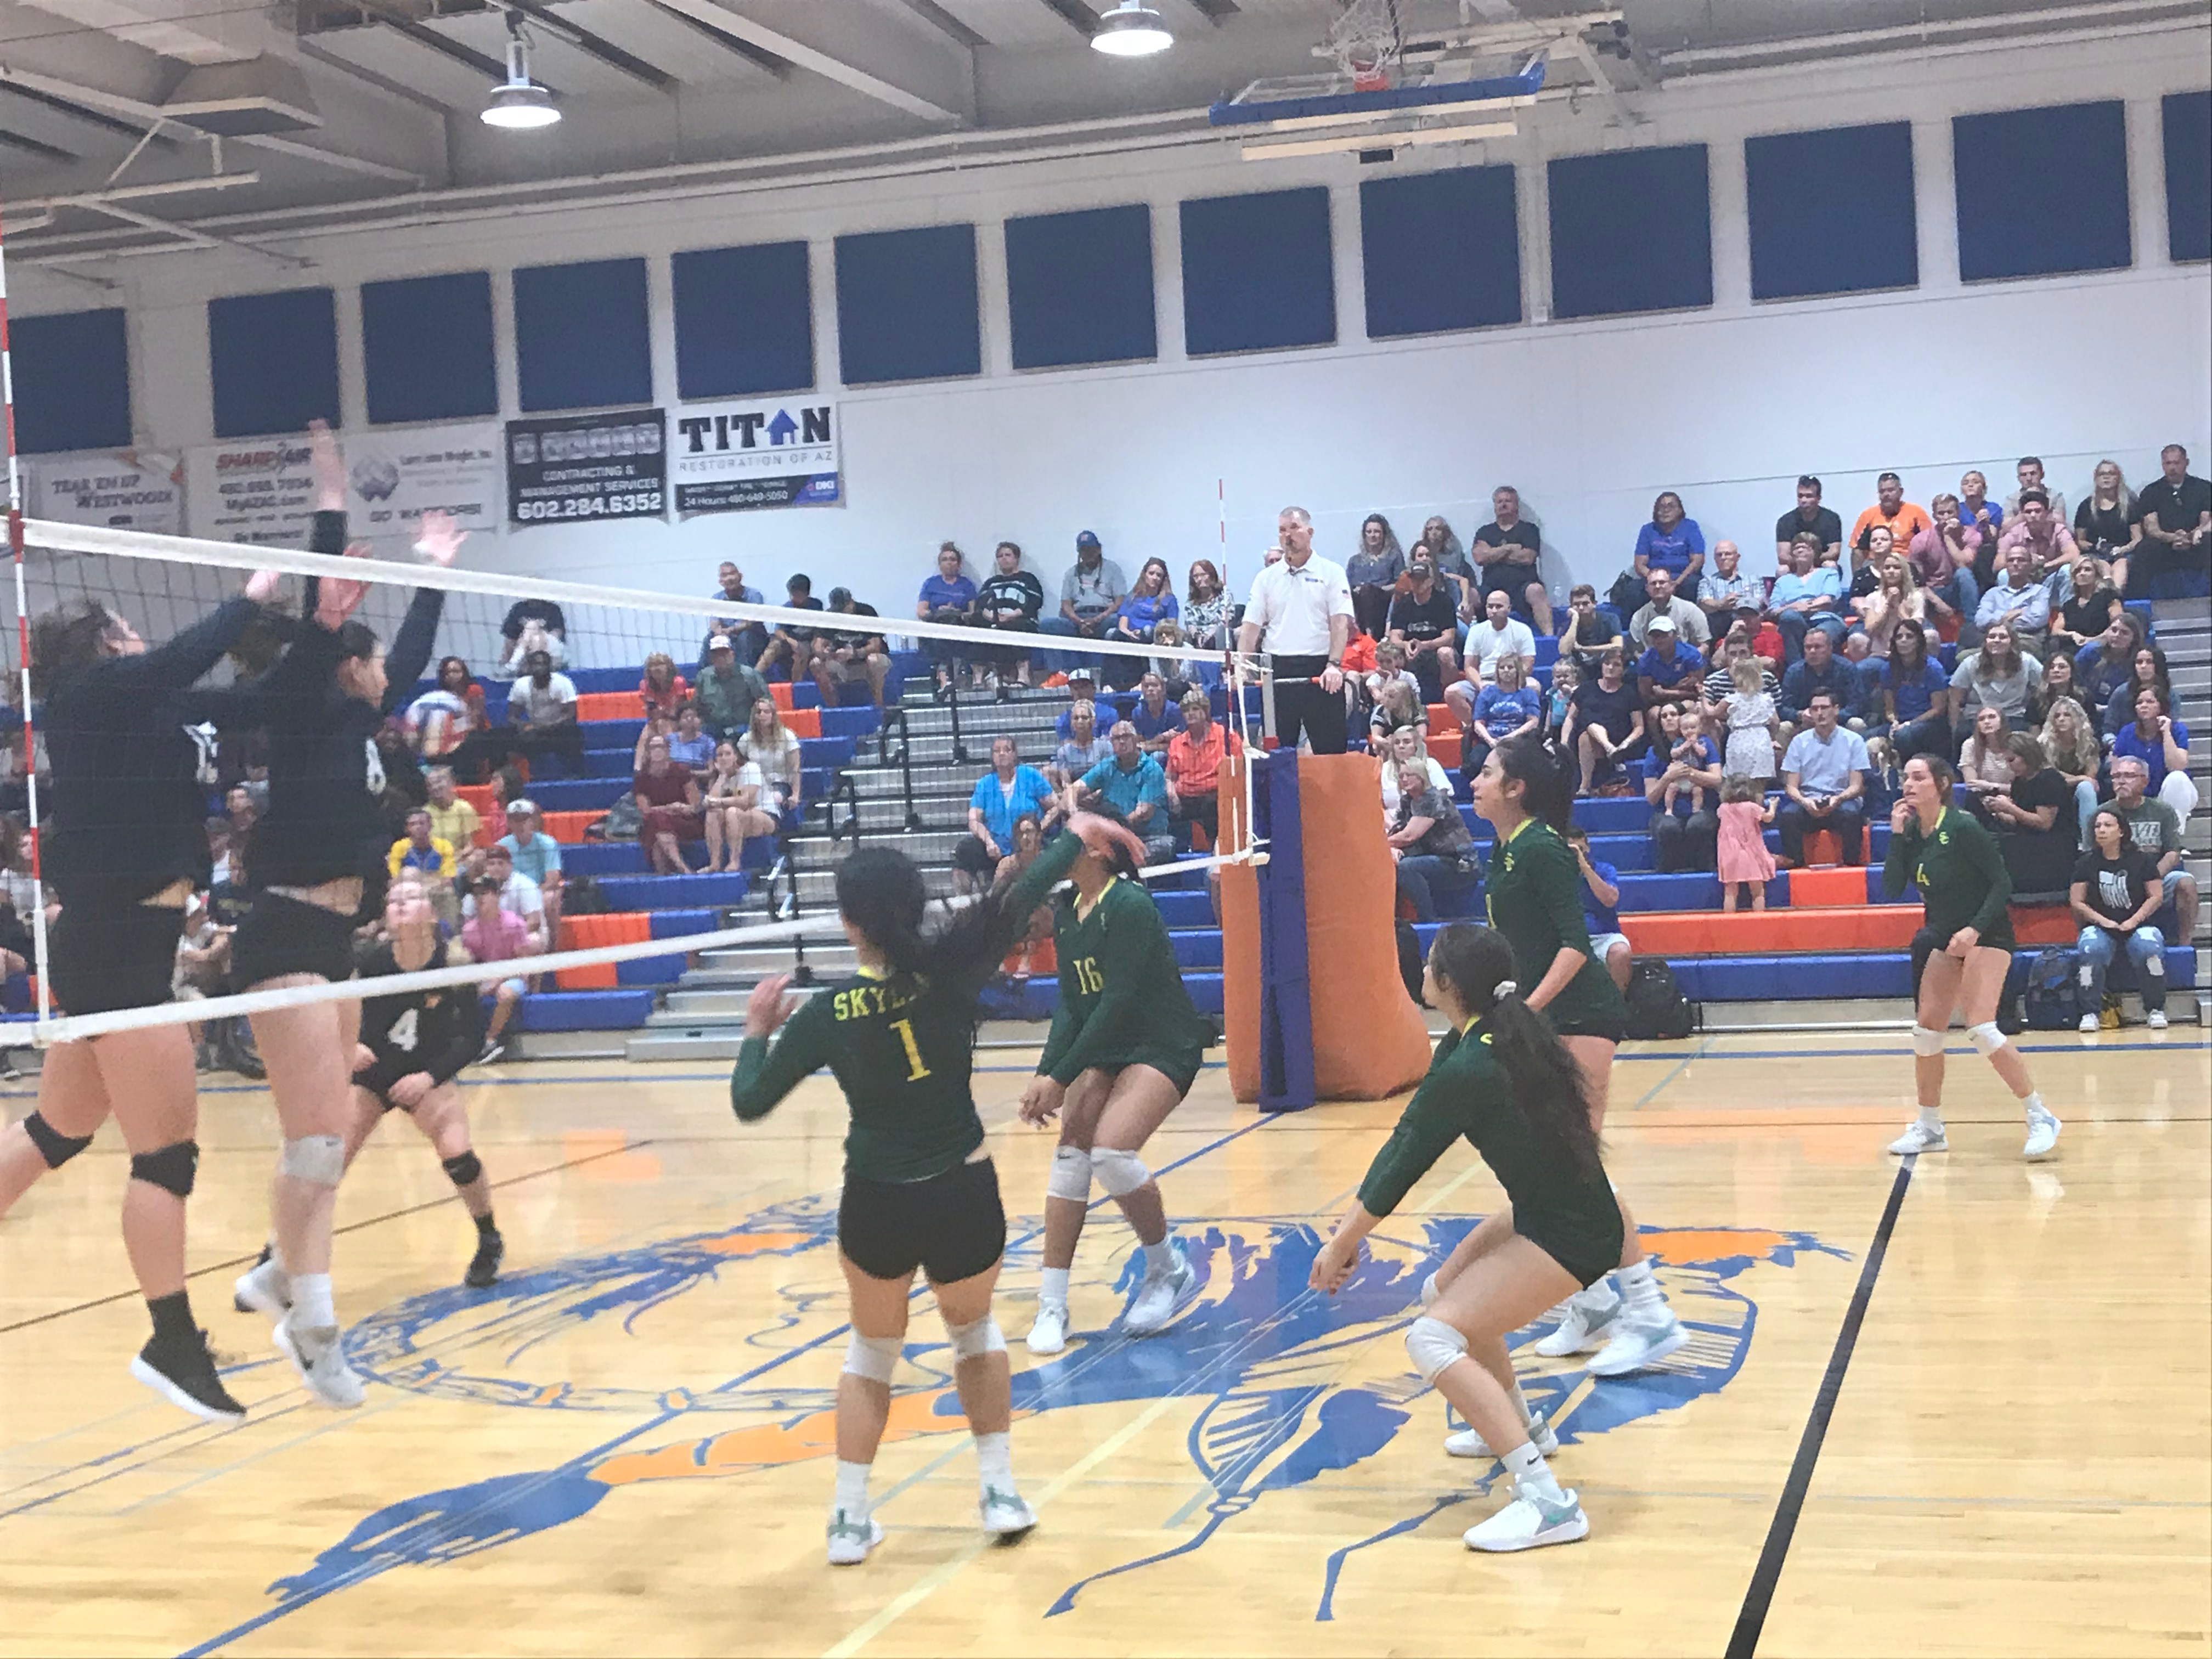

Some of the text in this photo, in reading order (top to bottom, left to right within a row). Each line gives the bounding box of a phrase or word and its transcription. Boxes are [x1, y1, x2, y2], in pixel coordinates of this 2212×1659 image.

[542, 466, 623, 482] CONTRACTING
[679, 451, 832, 472] RESTORATION OF AZ
[604, 478, 659, 492] SERVICES
[517, 492, 662, 520] 602.284.6352
[1073, 956, 1103, 995] 16
[387, 1008, 419, 1052] 4
[888, 1018, 931, 1082] 1
